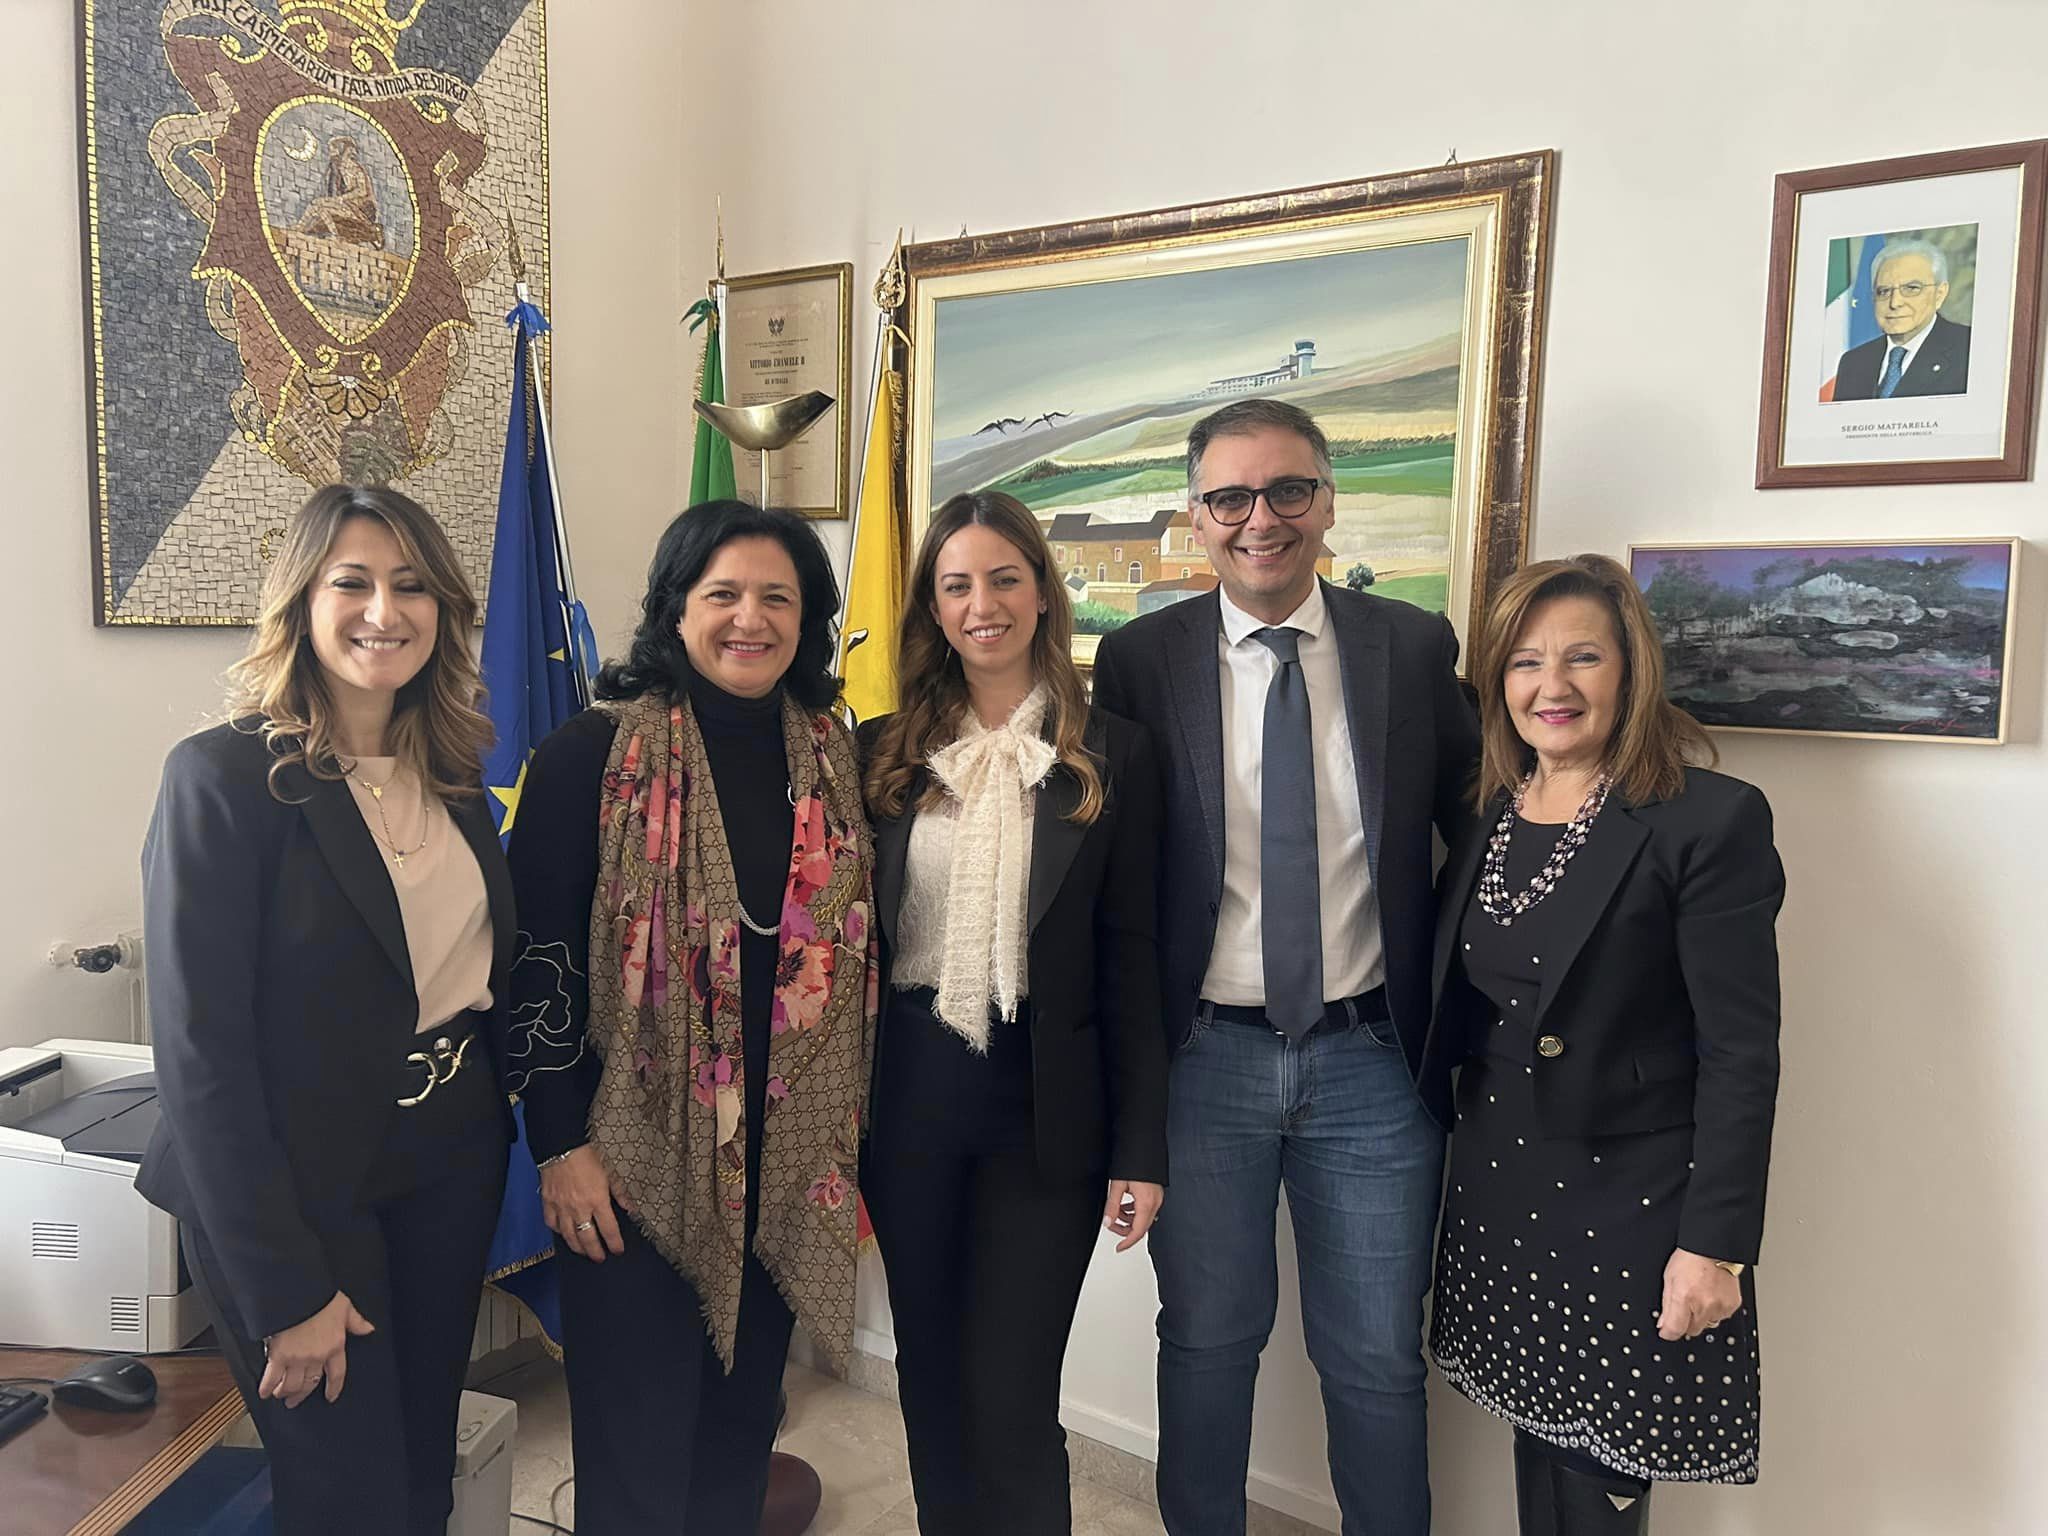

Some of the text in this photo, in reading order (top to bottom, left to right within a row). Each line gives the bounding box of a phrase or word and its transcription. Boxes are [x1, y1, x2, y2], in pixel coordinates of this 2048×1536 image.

[232, 6, 337, 88] CASMENARUM
[341, 75, 373, 98] FATA
[413, 72, 468, 102] RESURGO
[1841, 420, 1939, 433] SERGIO MATTARELLA
